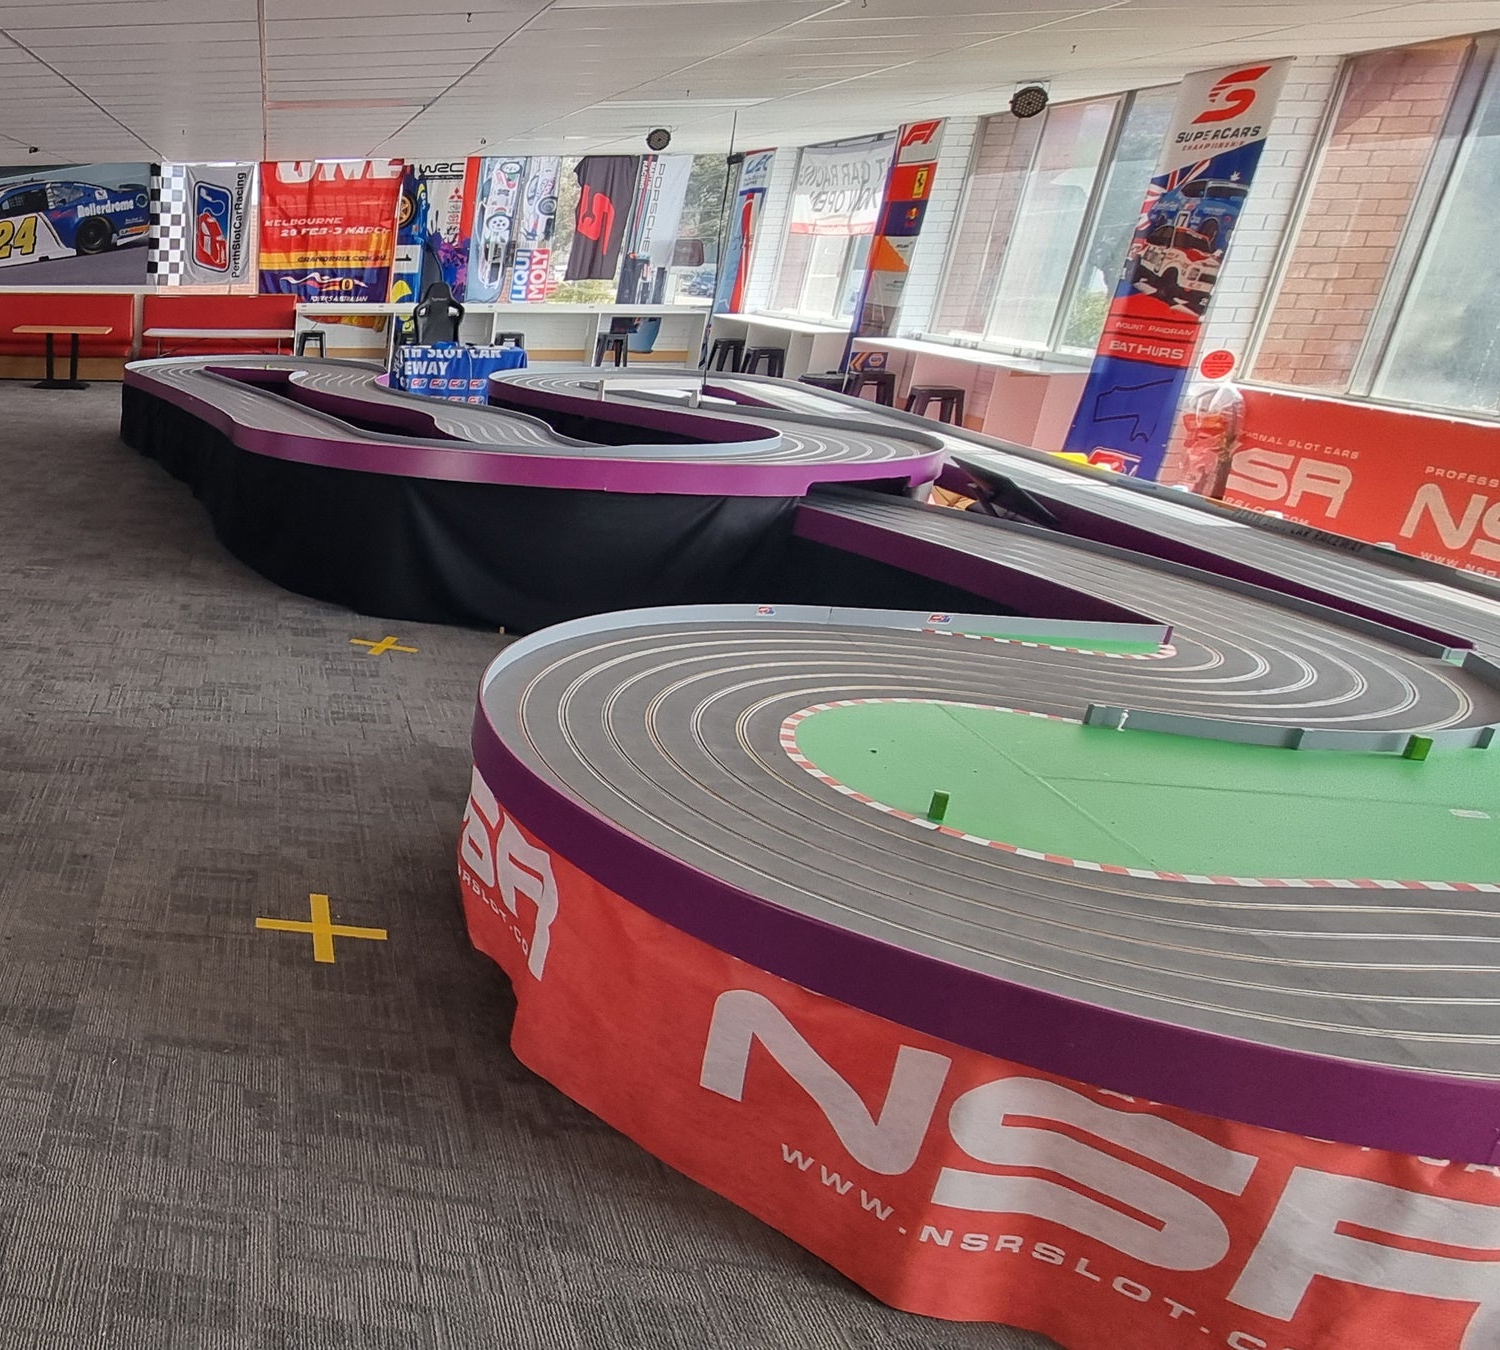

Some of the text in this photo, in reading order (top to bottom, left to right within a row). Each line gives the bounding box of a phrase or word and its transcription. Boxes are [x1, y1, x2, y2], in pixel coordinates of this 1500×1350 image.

[1175, 125, 1262, 143] SUPERCARS
[419, 162, 465, 174] WRC
[232, 172, 247, 279] PerthSlotCarRacing
[264, 216, 344, 228] MELBOURNE
[641, 163, 666, 253] PORSCHE
[511, 251, 532, 299] LIQUI
[527, 250, 549, 299] MOLY
[1288, 439, 1320, 452] SLOT
[1324, 446, 1359, 460] CARS
[780, 1142, 1294, 1350] WWW.NSRSLOT.C
